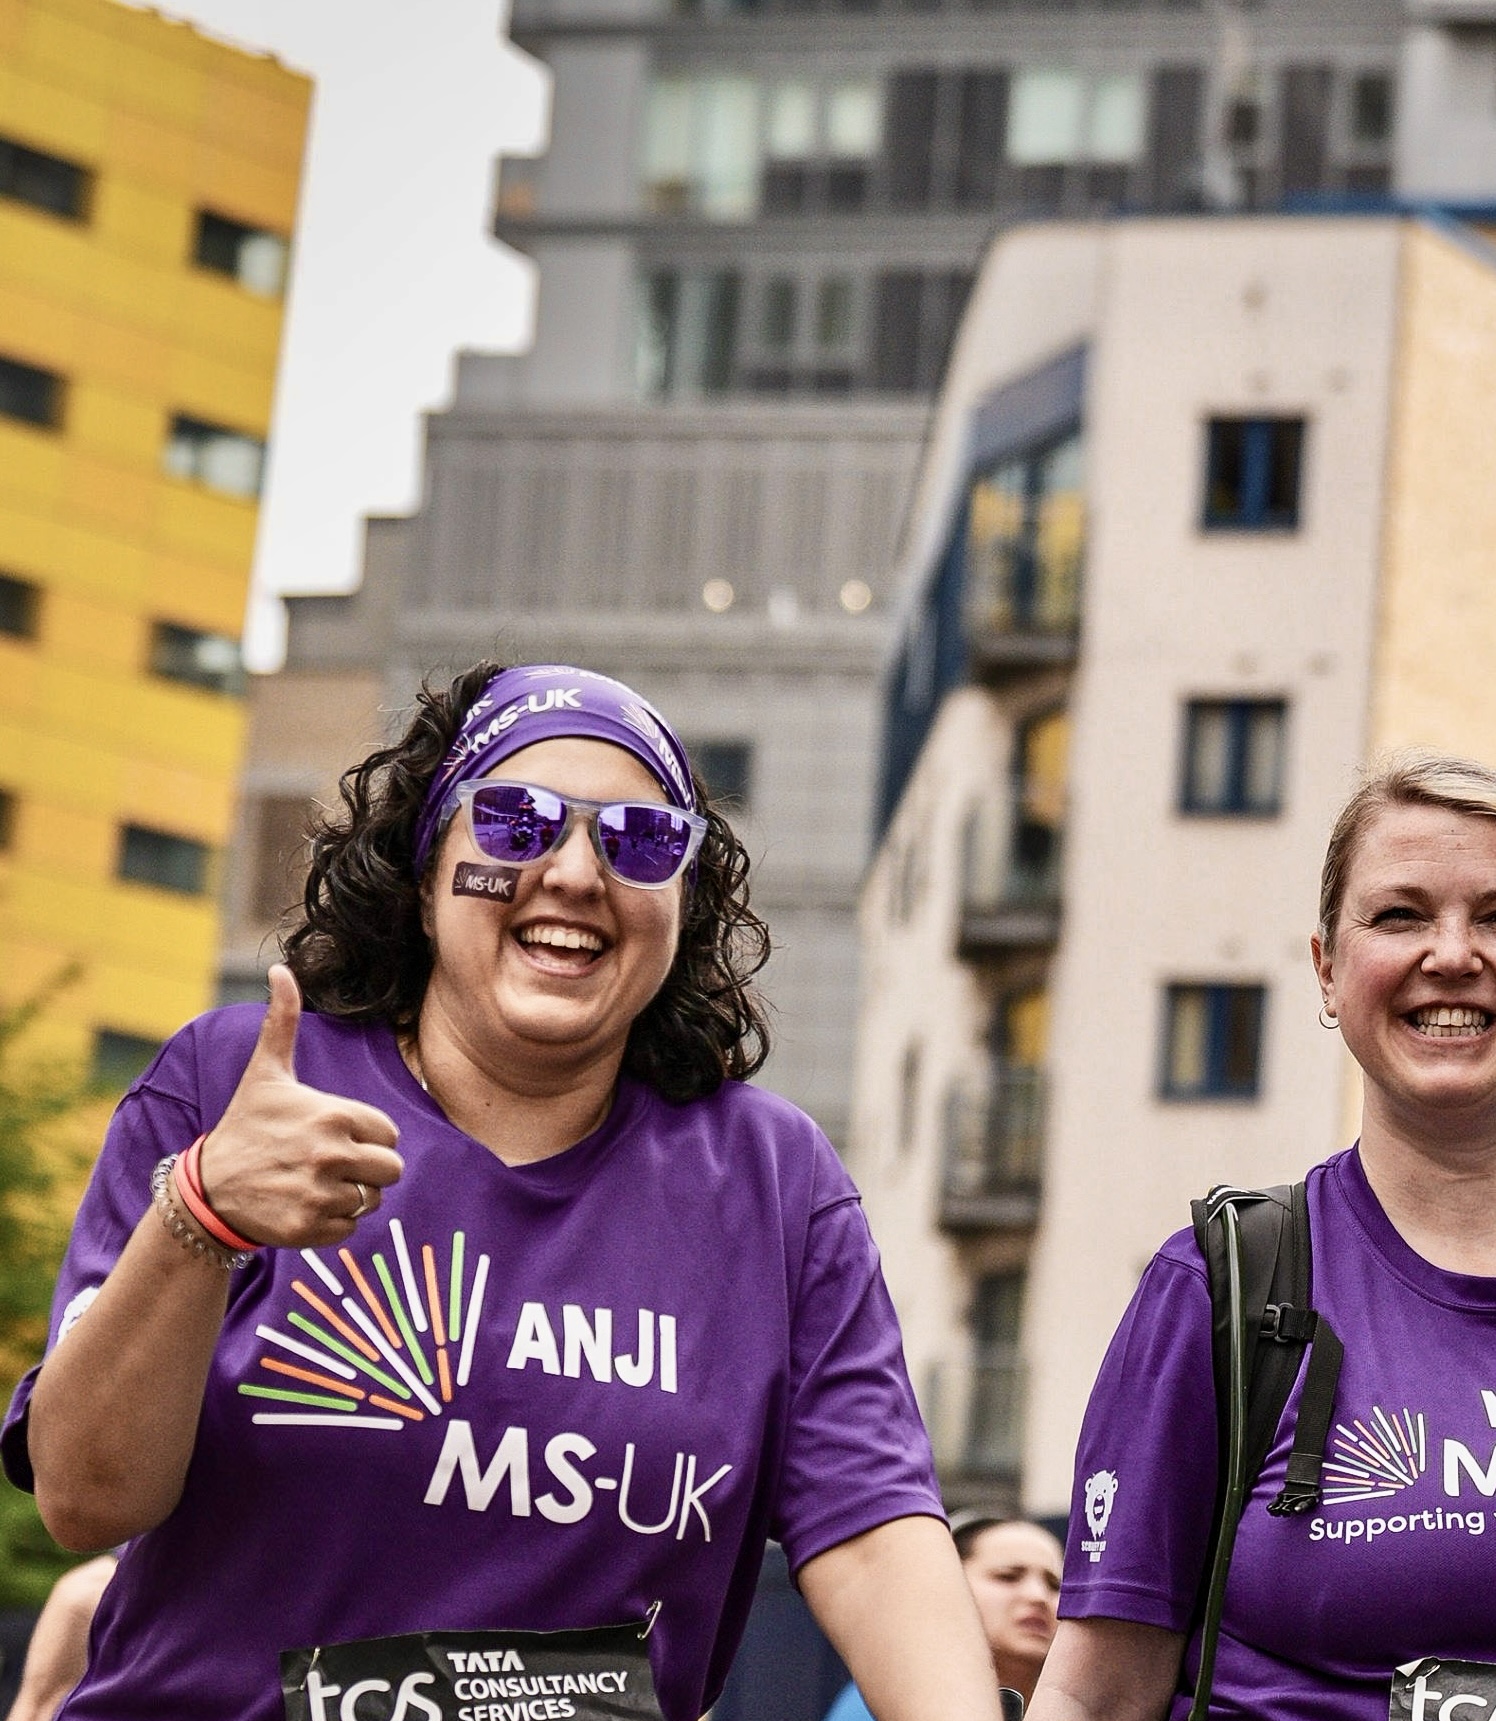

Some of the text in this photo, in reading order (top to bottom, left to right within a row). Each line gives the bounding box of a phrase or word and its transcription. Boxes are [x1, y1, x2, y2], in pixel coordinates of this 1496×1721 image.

[471, 688, 582, 754] MS-UK
[465, 873, 512, 895] MS-UK
[506, 1301, 678, 1394] ANJI
[423, 1419, 733, 1543] MS-UK
[1308, 1508, 1485, 1544] Supporting
[447, 1650, 525, 1673] TATA
[453, 1671, 629, 1701] CONSULTANCY
